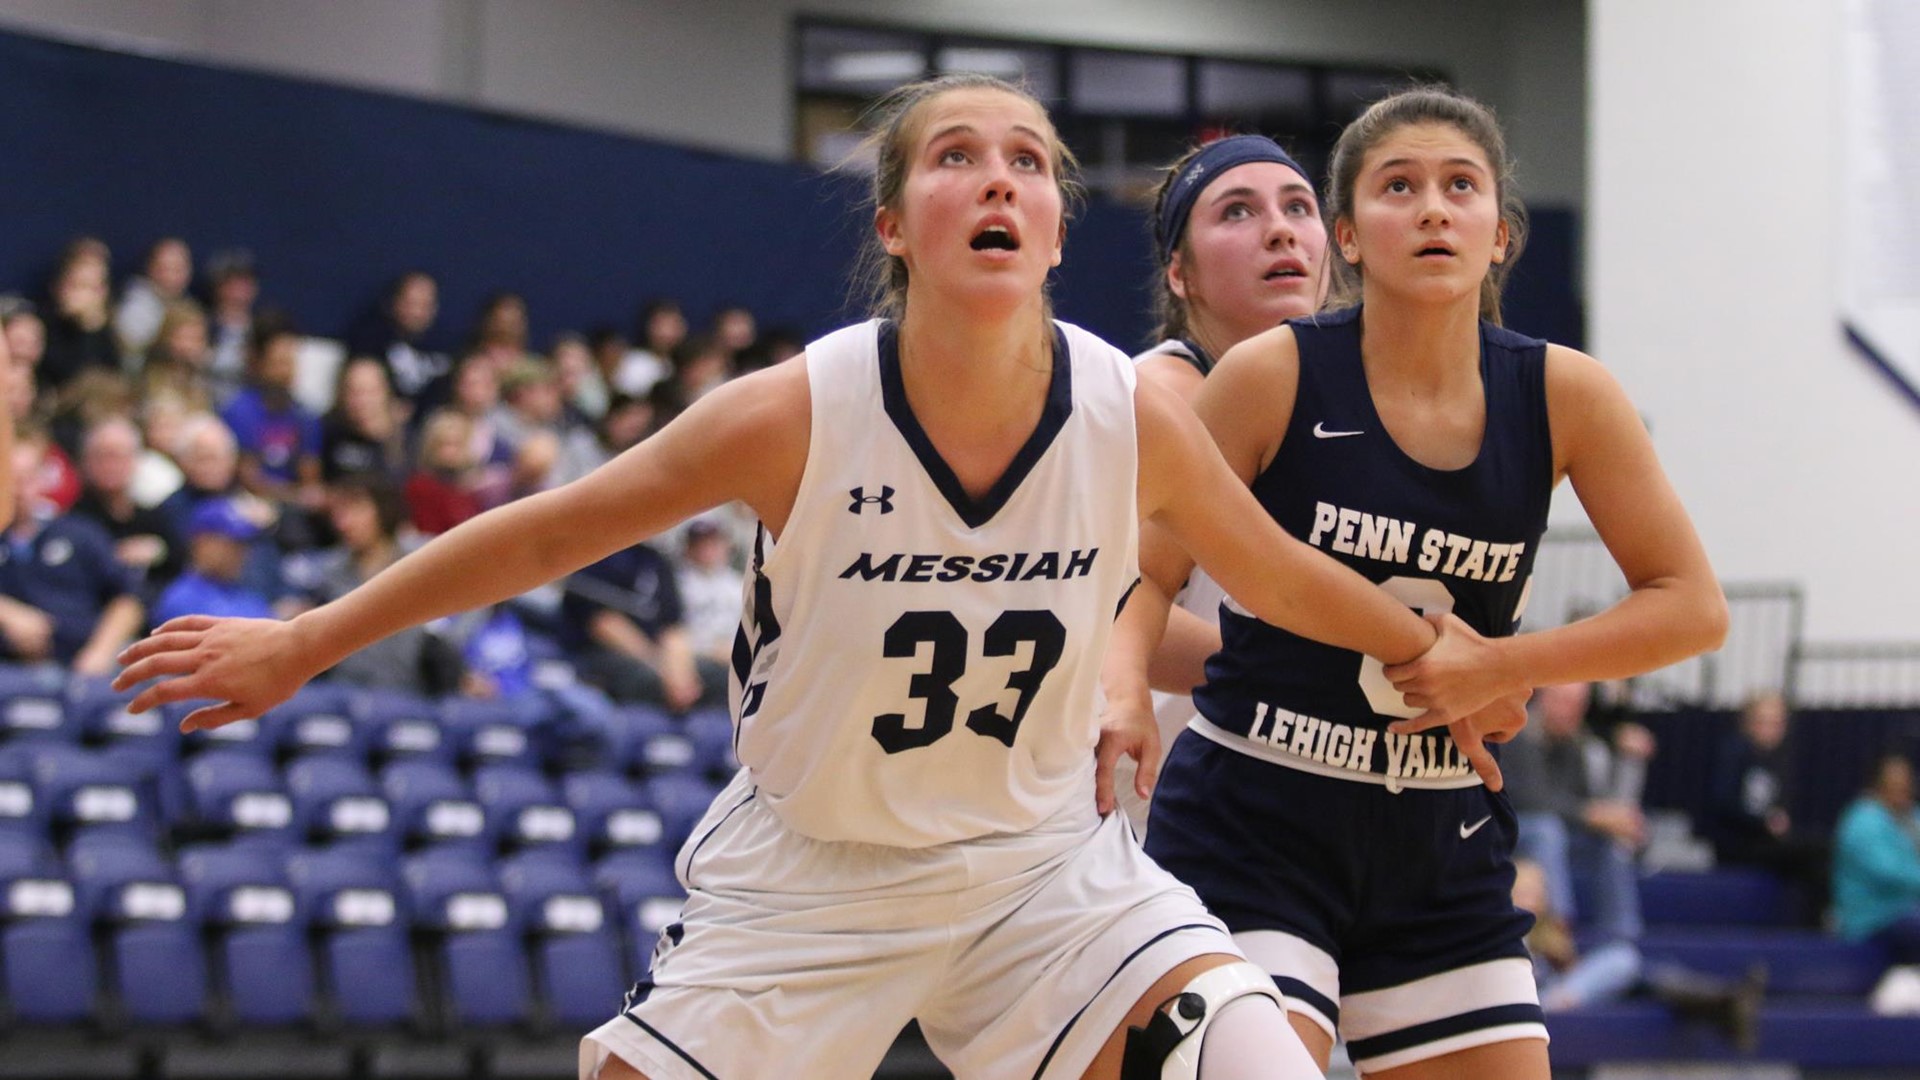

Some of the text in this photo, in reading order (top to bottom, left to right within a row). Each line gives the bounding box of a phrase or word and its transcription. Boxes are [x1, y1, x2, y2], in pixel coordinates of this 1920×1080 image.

[838, 547, 1099, 583] MESSIAH
[1309, 501, 1525, 583] PENN STATE
[871, 610, 1067, 755] 33
[1248, 702, 1479, 778] LEHIGH VALLE
